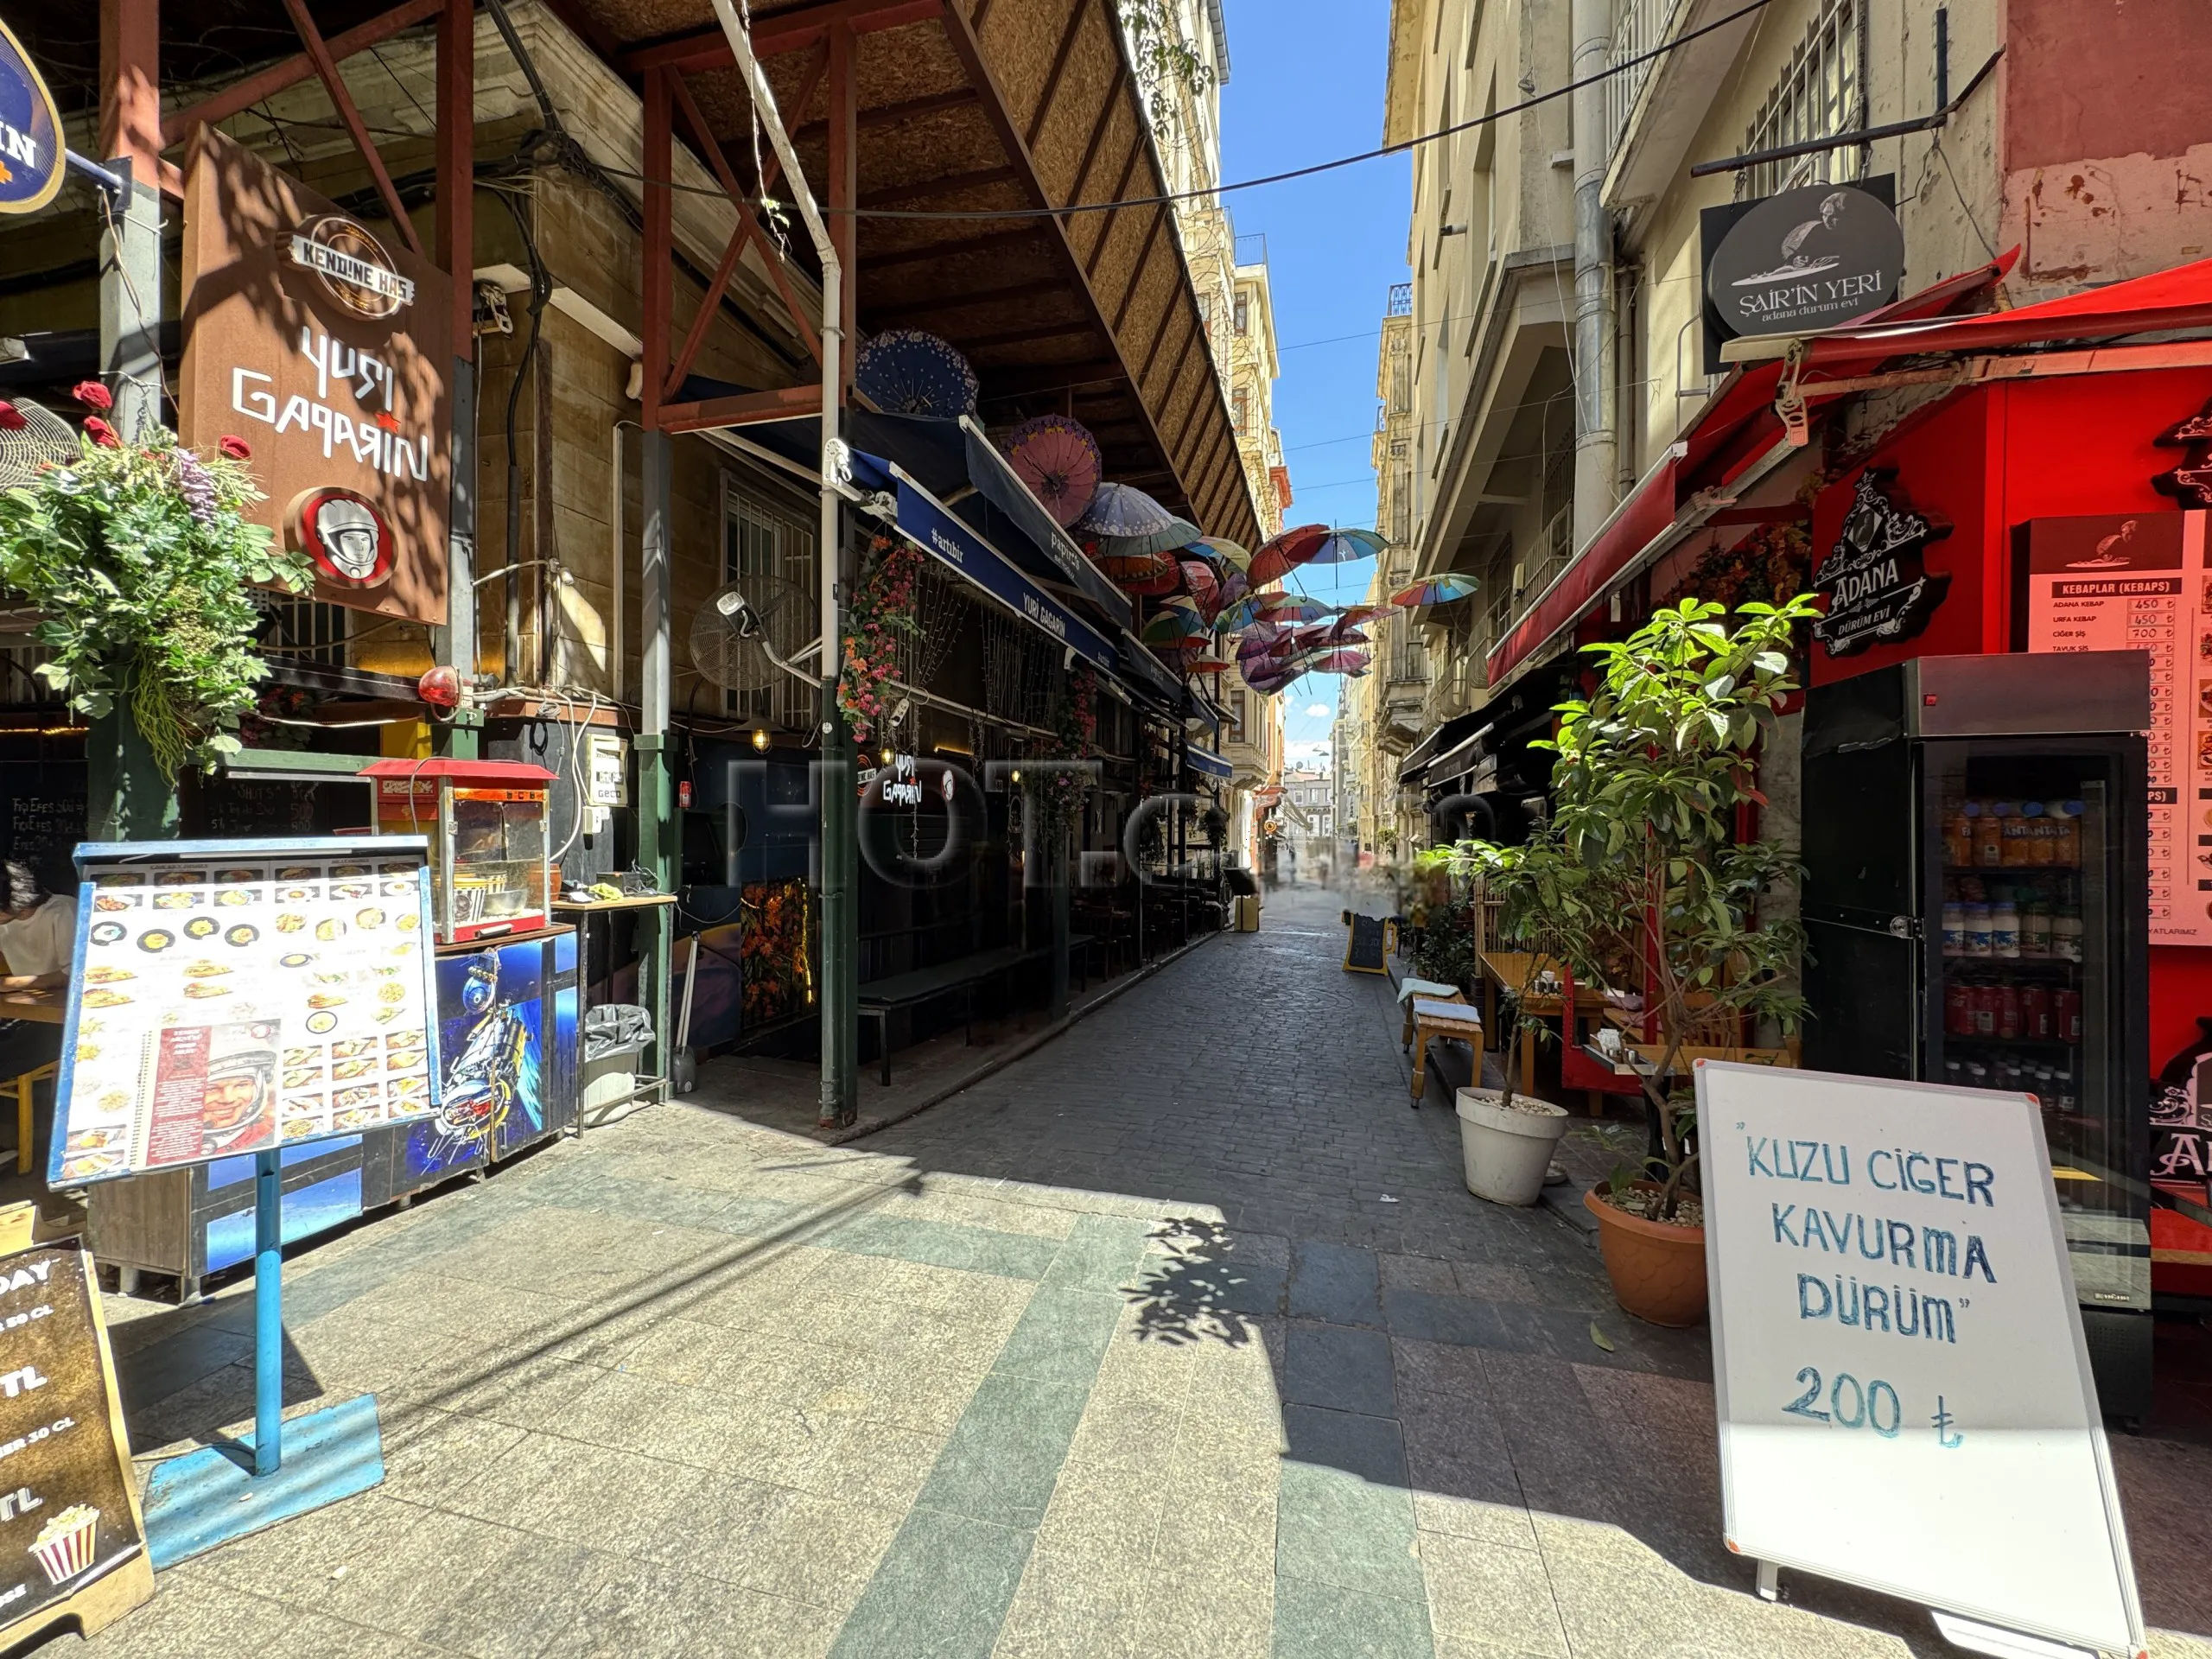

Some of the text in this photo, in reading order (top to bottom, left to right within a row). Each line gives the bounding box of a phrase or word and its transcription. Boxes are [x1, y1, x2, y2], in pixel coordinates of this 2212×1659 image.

[378, 272, 407, 299] HAS
[1825, 270, 1882, 298] YERİ
[1762, 308, 1796, 322] adana
[1827, 558, 1899, 617] ADANA
[2063, 580, 2171, 595] KEBAPLAR (KEBAPS)
[1838, 603, 1891, 636] DÜRÜM EVİ
[2132, 628, 2157, 638] 700
[1866, 1147, 1995, 1208] CİĞER
[6, 1313, 29, 1328] 50
[0, 1365, 48, 1398] TL
[1781, 1365, 1901, 1440] 200
[28, 1427, 50, 1443] 30
[52, 1416, 76, 1432] CL
